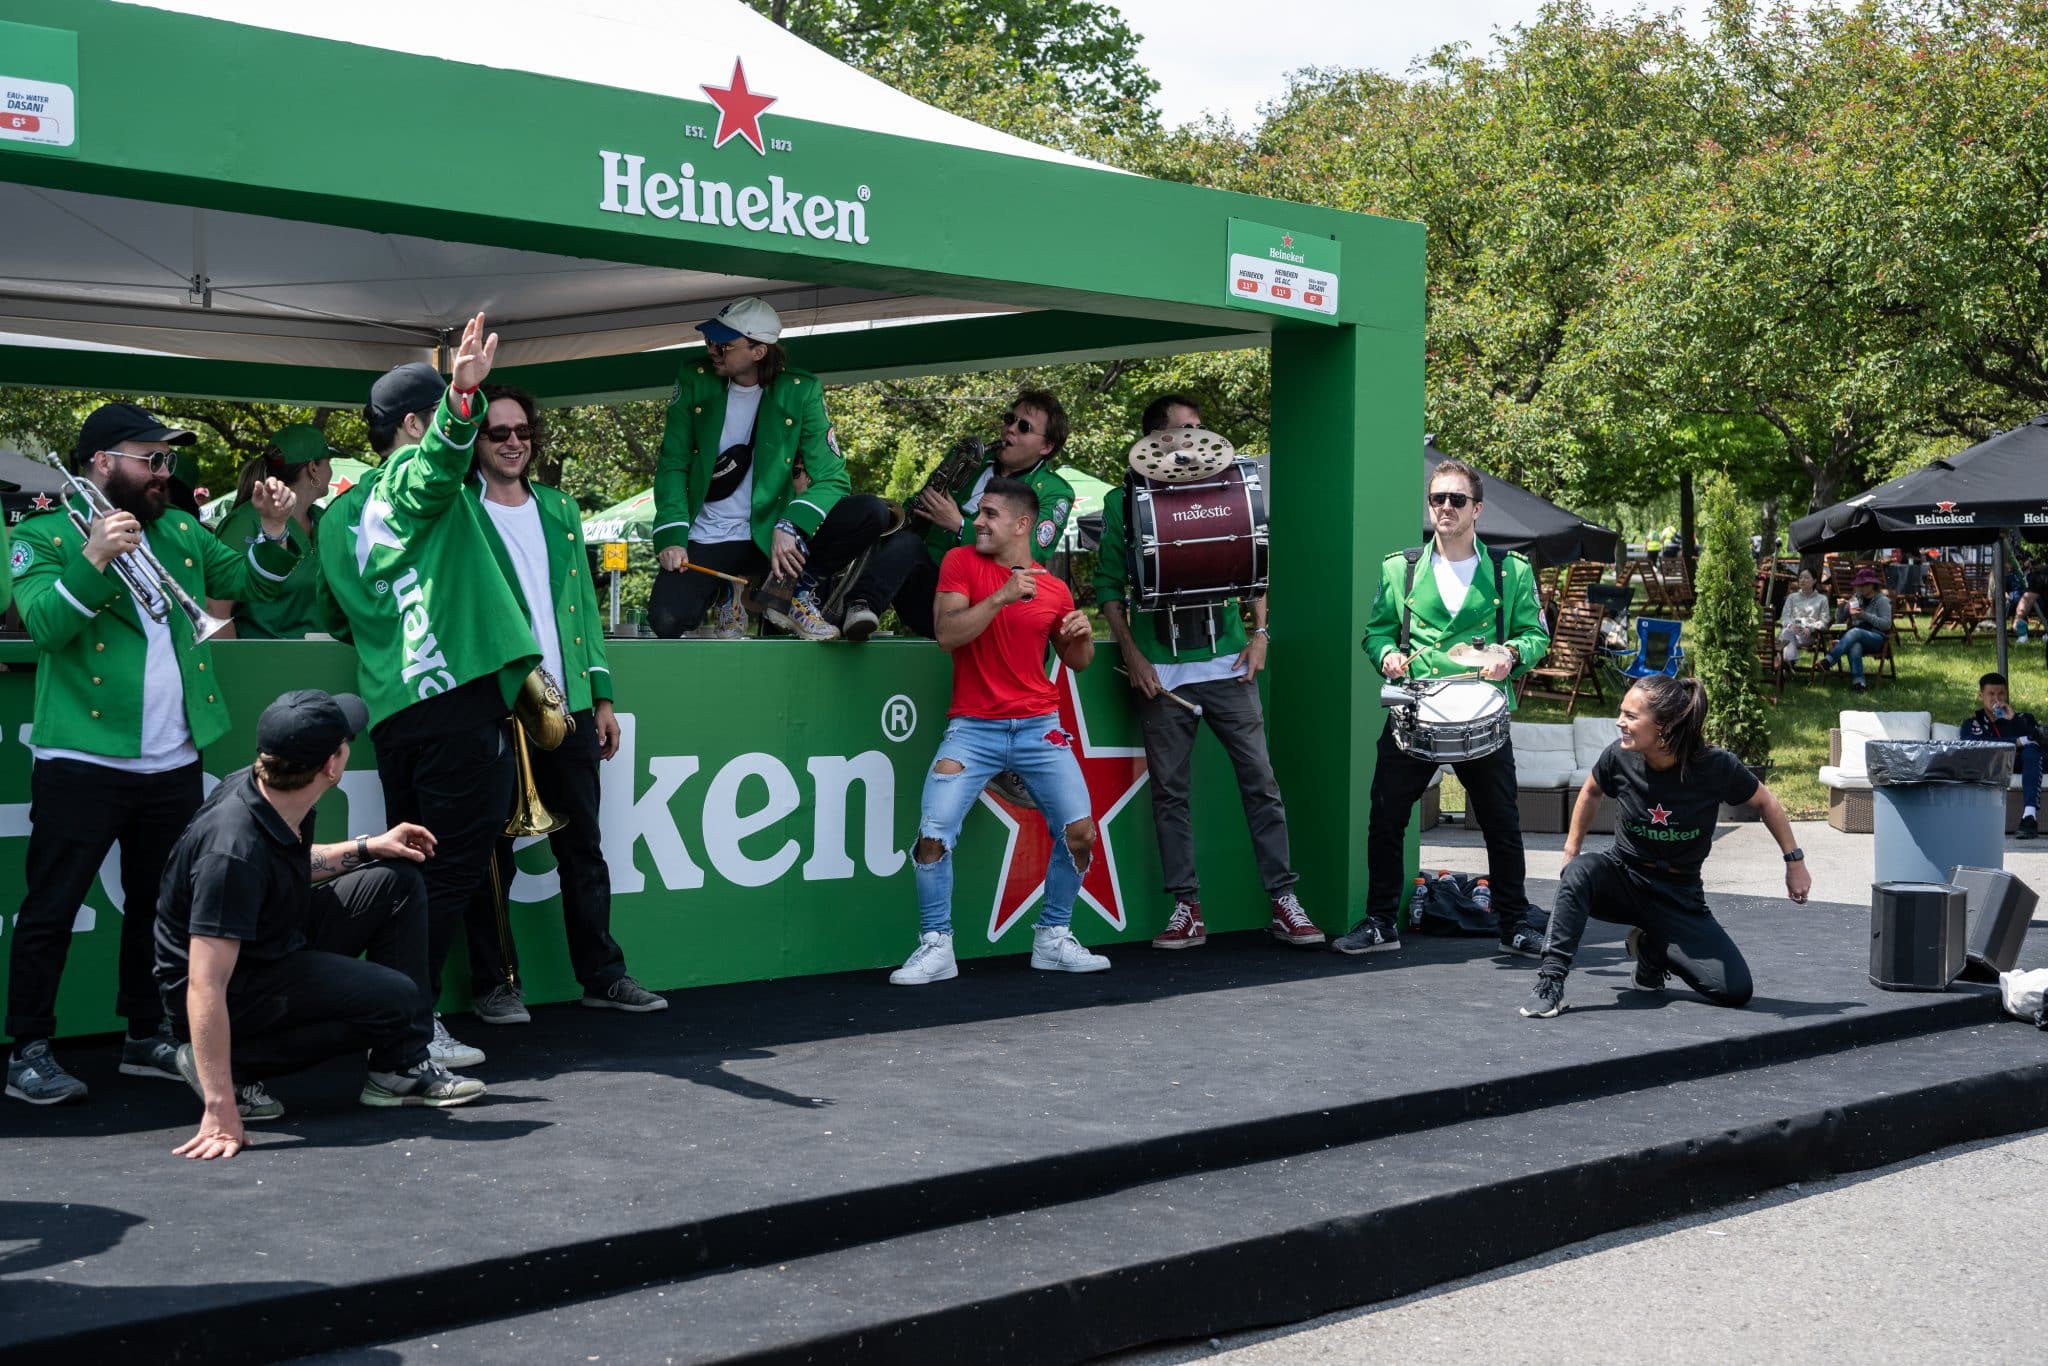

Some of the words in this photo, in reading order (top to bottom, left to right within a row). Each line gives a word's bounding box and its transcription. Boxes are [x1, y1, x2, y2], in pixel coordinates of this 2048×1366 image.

[7, 99, 44, 113] DASANI
[26, 94, 49, 103] WATER
[685, 125, 708, 139] EST.
[771, 138, 792, 152] 1873
[1269, 247, 1305, 264] Heineken
[1173, 504, 1232, 522] majestic
